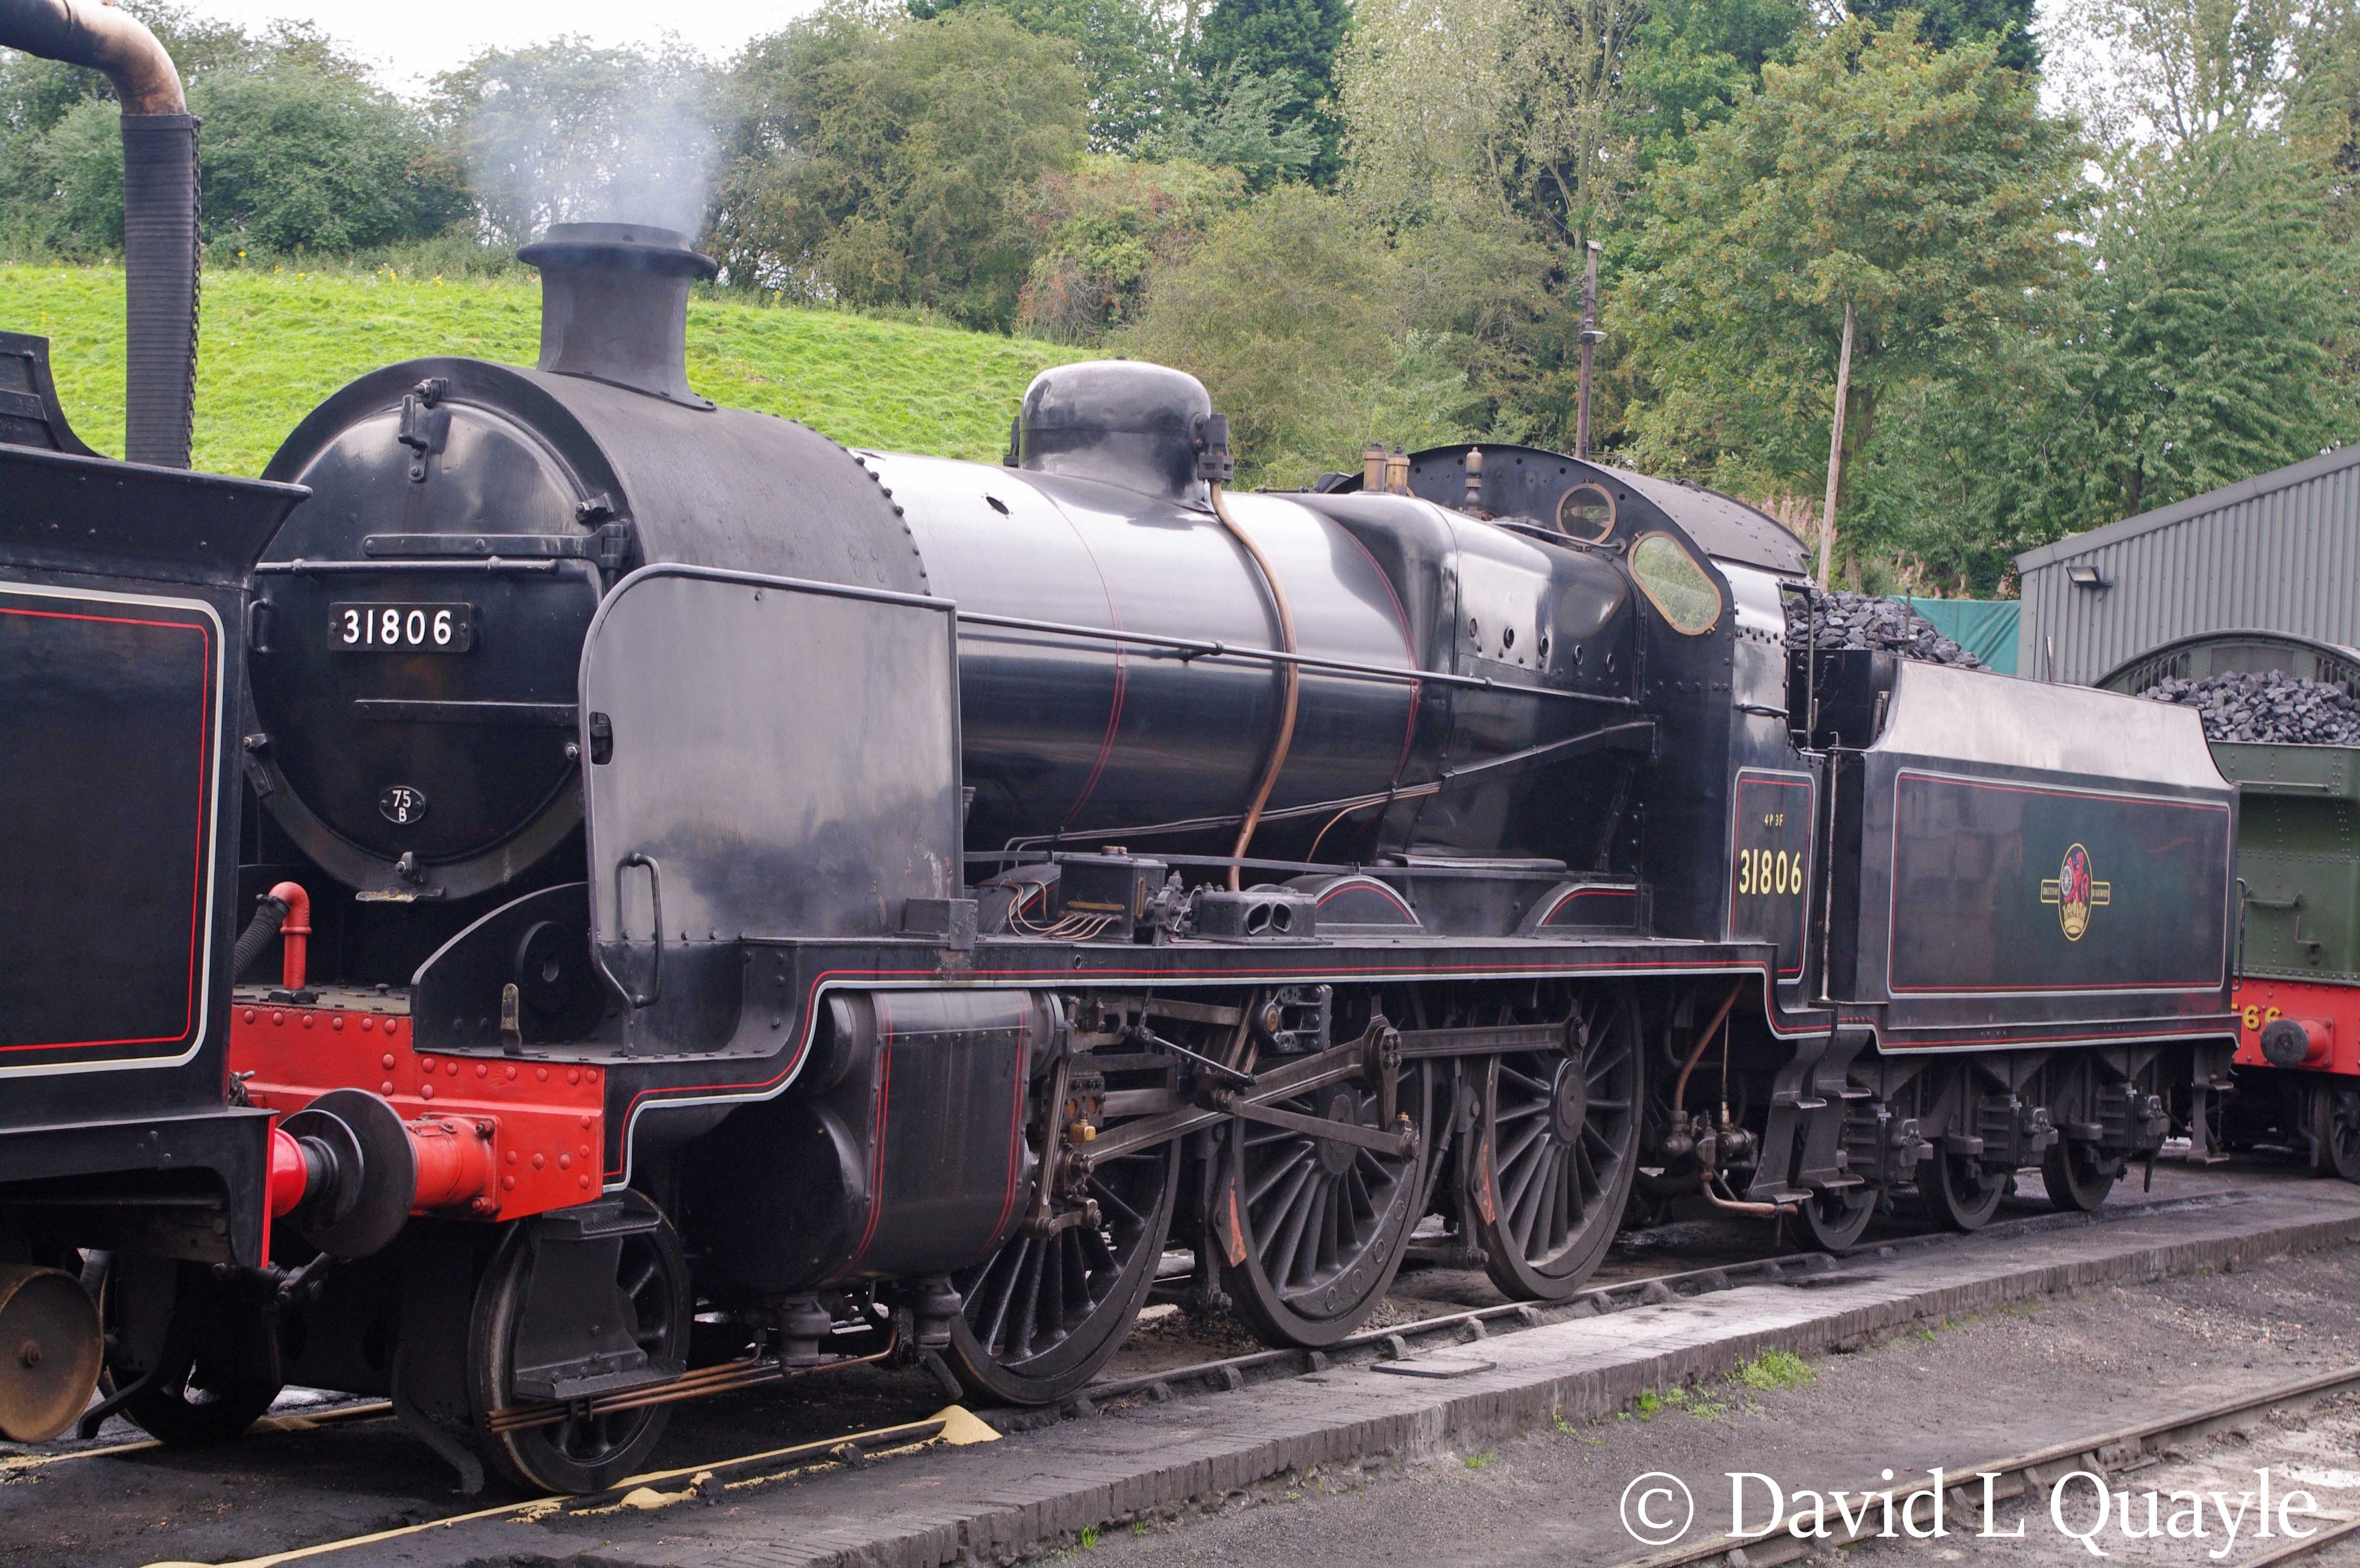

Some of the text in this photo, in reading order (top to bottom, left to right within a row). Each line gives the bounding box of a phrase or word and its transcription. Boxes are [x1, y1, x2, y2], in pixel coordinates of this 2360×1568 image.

[342, 609, 452, 645] 31806
[392, 789, 412, 808] 75
[399, 807, 407, 823] B
[1739, 848, 1802, 895] 31806
[2043, 887, 2058, 896] BRITISH
